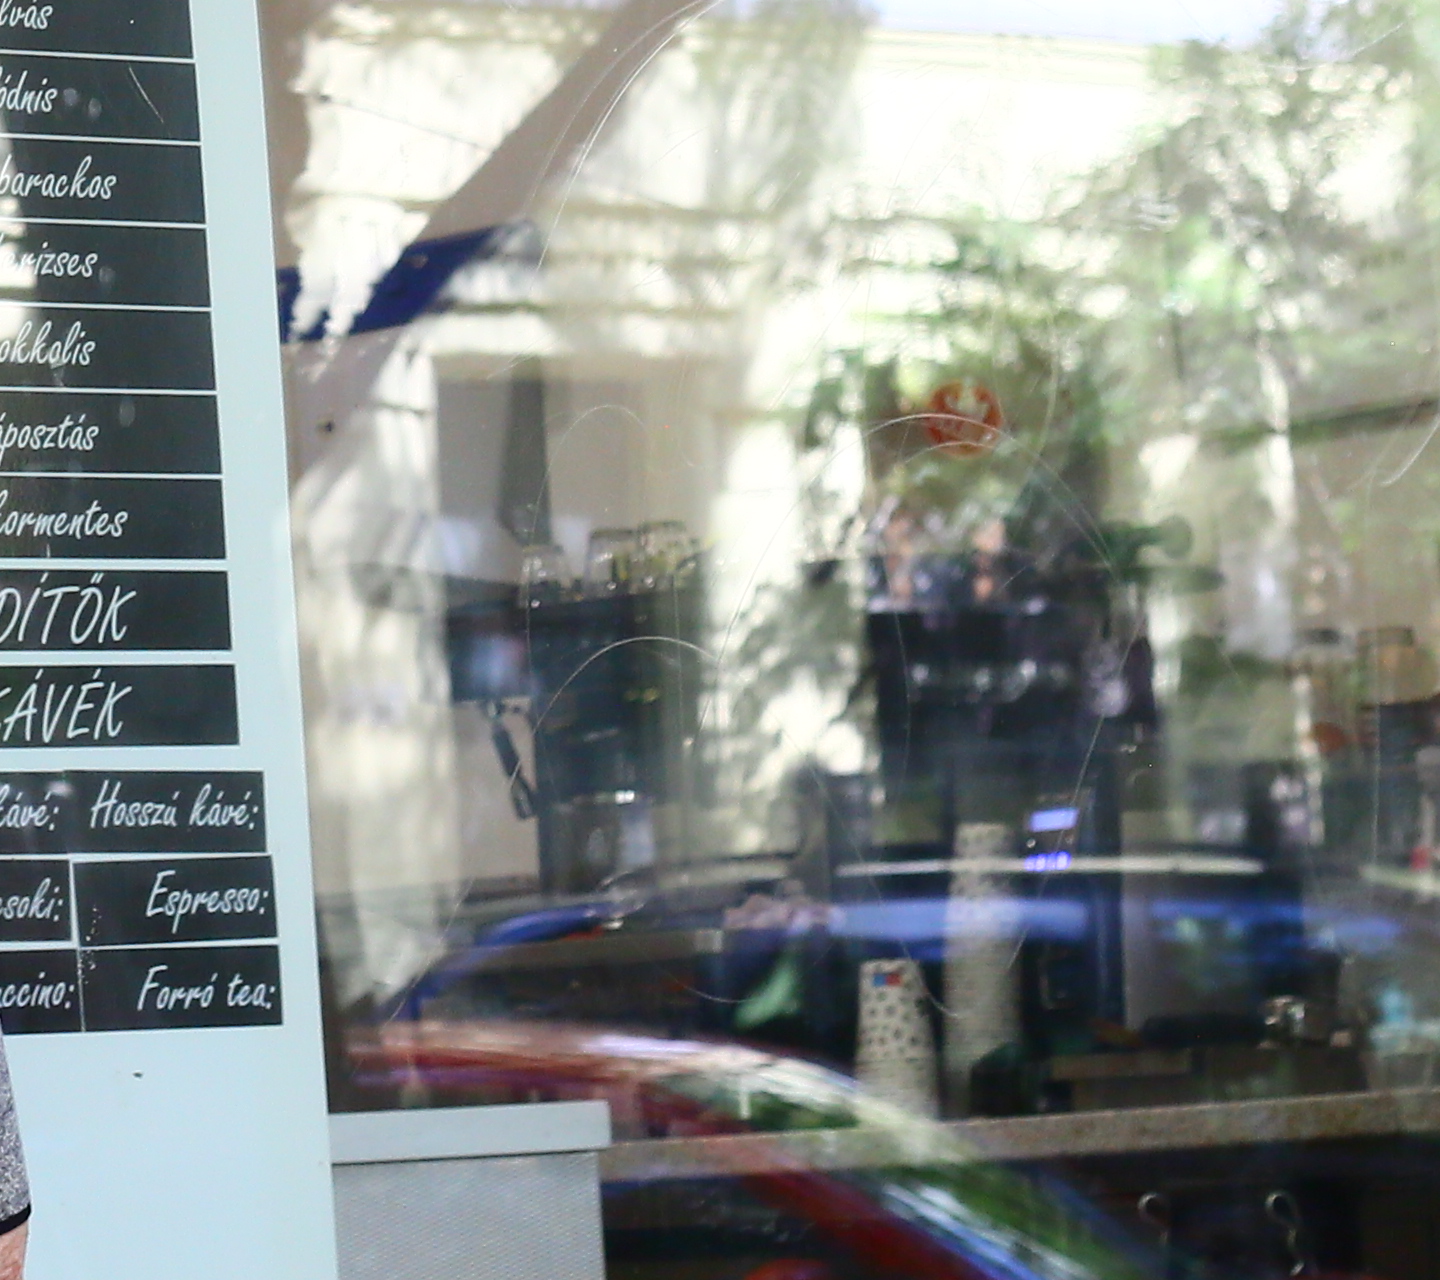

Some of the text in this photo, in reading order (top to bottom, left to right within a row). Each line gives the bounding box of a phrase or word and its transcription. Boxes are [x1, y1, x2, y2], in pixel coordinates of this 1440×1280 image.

[90, 780, 260, 830] Hosszú kávé:
[145, 869, 270, 934] Espresso:
[136, 964, 277, 1011] Forró tea:
